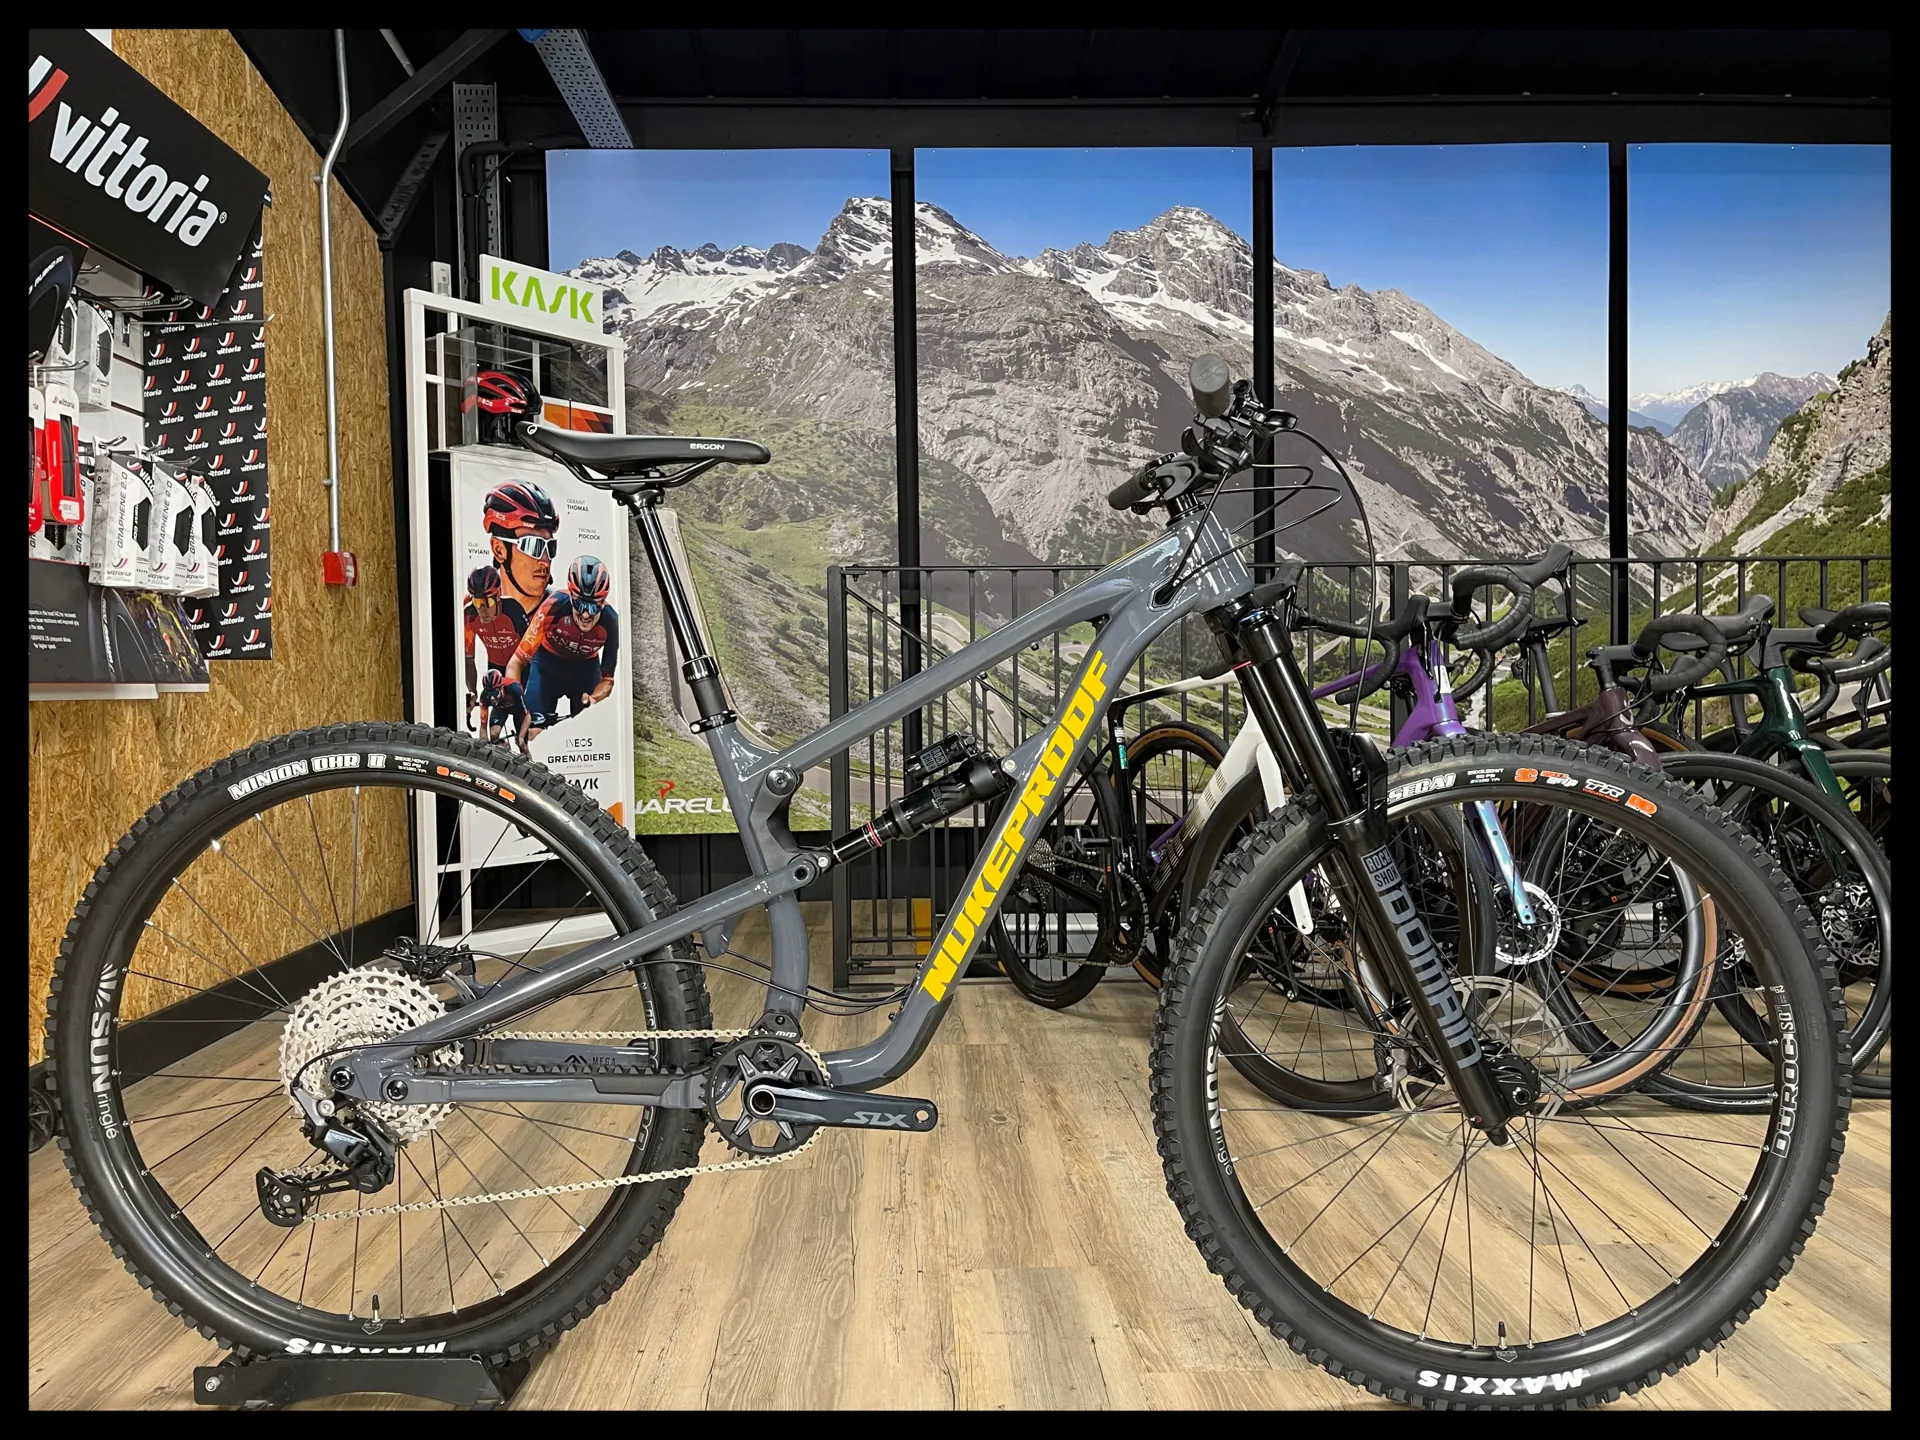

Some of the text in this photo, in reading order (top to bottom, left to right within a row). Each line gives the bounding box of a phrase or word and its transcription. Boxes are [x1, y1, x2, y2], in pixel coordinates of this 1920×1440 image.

[50, 101, 219, 247] vittoria
[239, 281, 263, 291] vittoria
[491, 266, 595, 325] KASK
[229, 313, 254, 321] vittoria
[160, 325, 185, 334] vittoria
[217, 346, 241, 355] vittoria
[182, 351, 207, 361] vittoria
[148, 357, 172, 366] vittoria
[241, 372, 265, 381] vittoria
[206, 378, 231, 387] vittoria
[144, 389, 162, 397] ttoria
[172, 383, 197, 393] vittoria
[228, 404, 253, 413] vittoria
[194, 410, 218, 419] vittoria
[159, 416, 184, 425] vittoria
[218, 436, 243, 446] vittoria
[184, 442, 209, 451] vittoria
[690, 443, 725, 451] ERGON
[241, 463, 265, 472] vittoria
[230, 494, 255, 504] vittoria
[566, 504, 589, 512] THOMAS
[117, 492, 129, 549] GRAPHENE
[157, 498, 170, 554] GRAPHENE
[218, 526, 243, 536] vittoria
[578, 533, 601, 541] PIDCOCK
[242, 552, 267, 562] vittoria
[468, 548, 490, 556] VIVIANI
[230, 585, 255, 594] vittoria
[254, 611, 272, 620] vitto
[220, 616, 245, 626] vittoria
[191, 622, 210, 631] ttoria
[482, 635, 513, 643] INEOS
[241, 641, 266, 651] vittoria
[206, 648, 232, 657] vittoria
[565, 737, 593, 748] INEOS
[547, 752, 611, 764] GRENADIERS
[931, 747, 947, 766] ROCK
[922, 753, 937, 772] SHOX
[228, 761, 308, 801] MINION
[311, 753, 361, 773] DHR
[1387, 773, 1457, 802] SEGAI
[1585, 779, 1625, 798] TR
[919, 650, 1107, 1002] NUKEPROOF
[1366, 849, 1392, 872] ROCK
[1374, 866, 1400, 888] SHOX
[1379, 885, 1482, 1069] DOMAIN
[775, 1030, 797, 1039] mrp
[91, 1011, 112, 1093] SUN
[592, 1056, 616, 1066] MEGA
[1207, 1045, 1221, 1130] SUN
[843, 1110, 911, 1128] SLX
[329, 1133, 357, 1145] DEORE
[1417, 1368, 1584, 1396] MAXXIS
